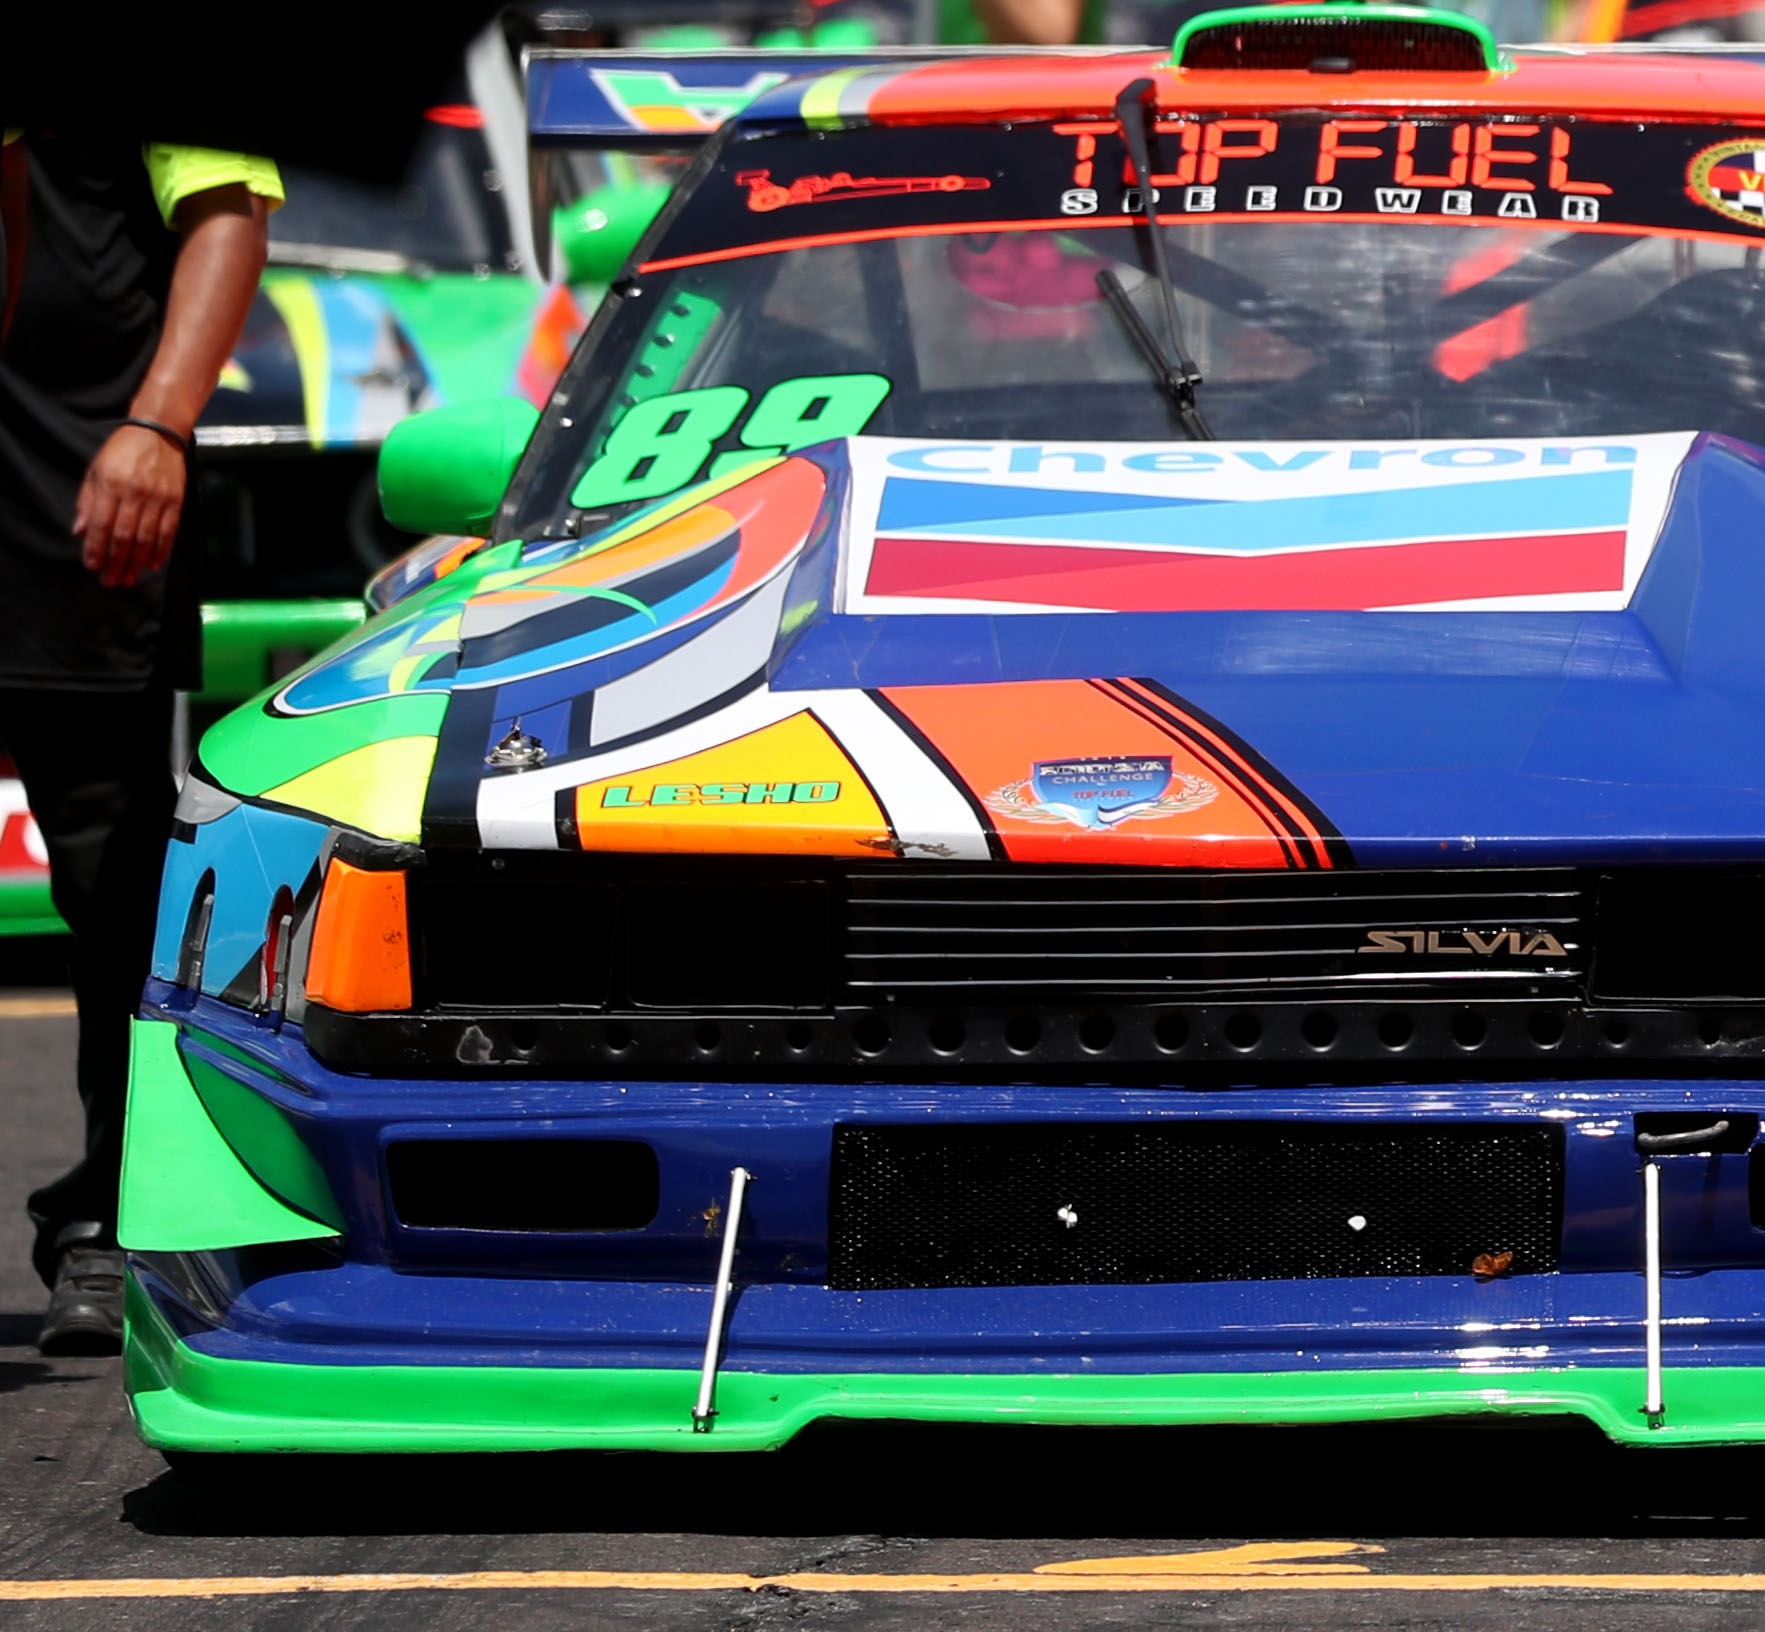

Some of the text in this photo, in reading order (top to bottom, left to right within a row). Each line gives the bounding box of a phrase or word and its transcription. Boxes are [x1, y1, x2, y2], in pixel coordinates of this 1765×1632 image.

[1053, 119, 1615, 196] TOP FUEL
[1061, 186, 1600, 223] SPEEDWEAR
[571, 373, 892, 509] 89
[886, 442, 1638, 474] Chevron
[601, 781, 841, 808] LESHO
[1052, 772, 1155, 785] CHALLENGE
[1357, 930, 1568, 956] SILVIA
